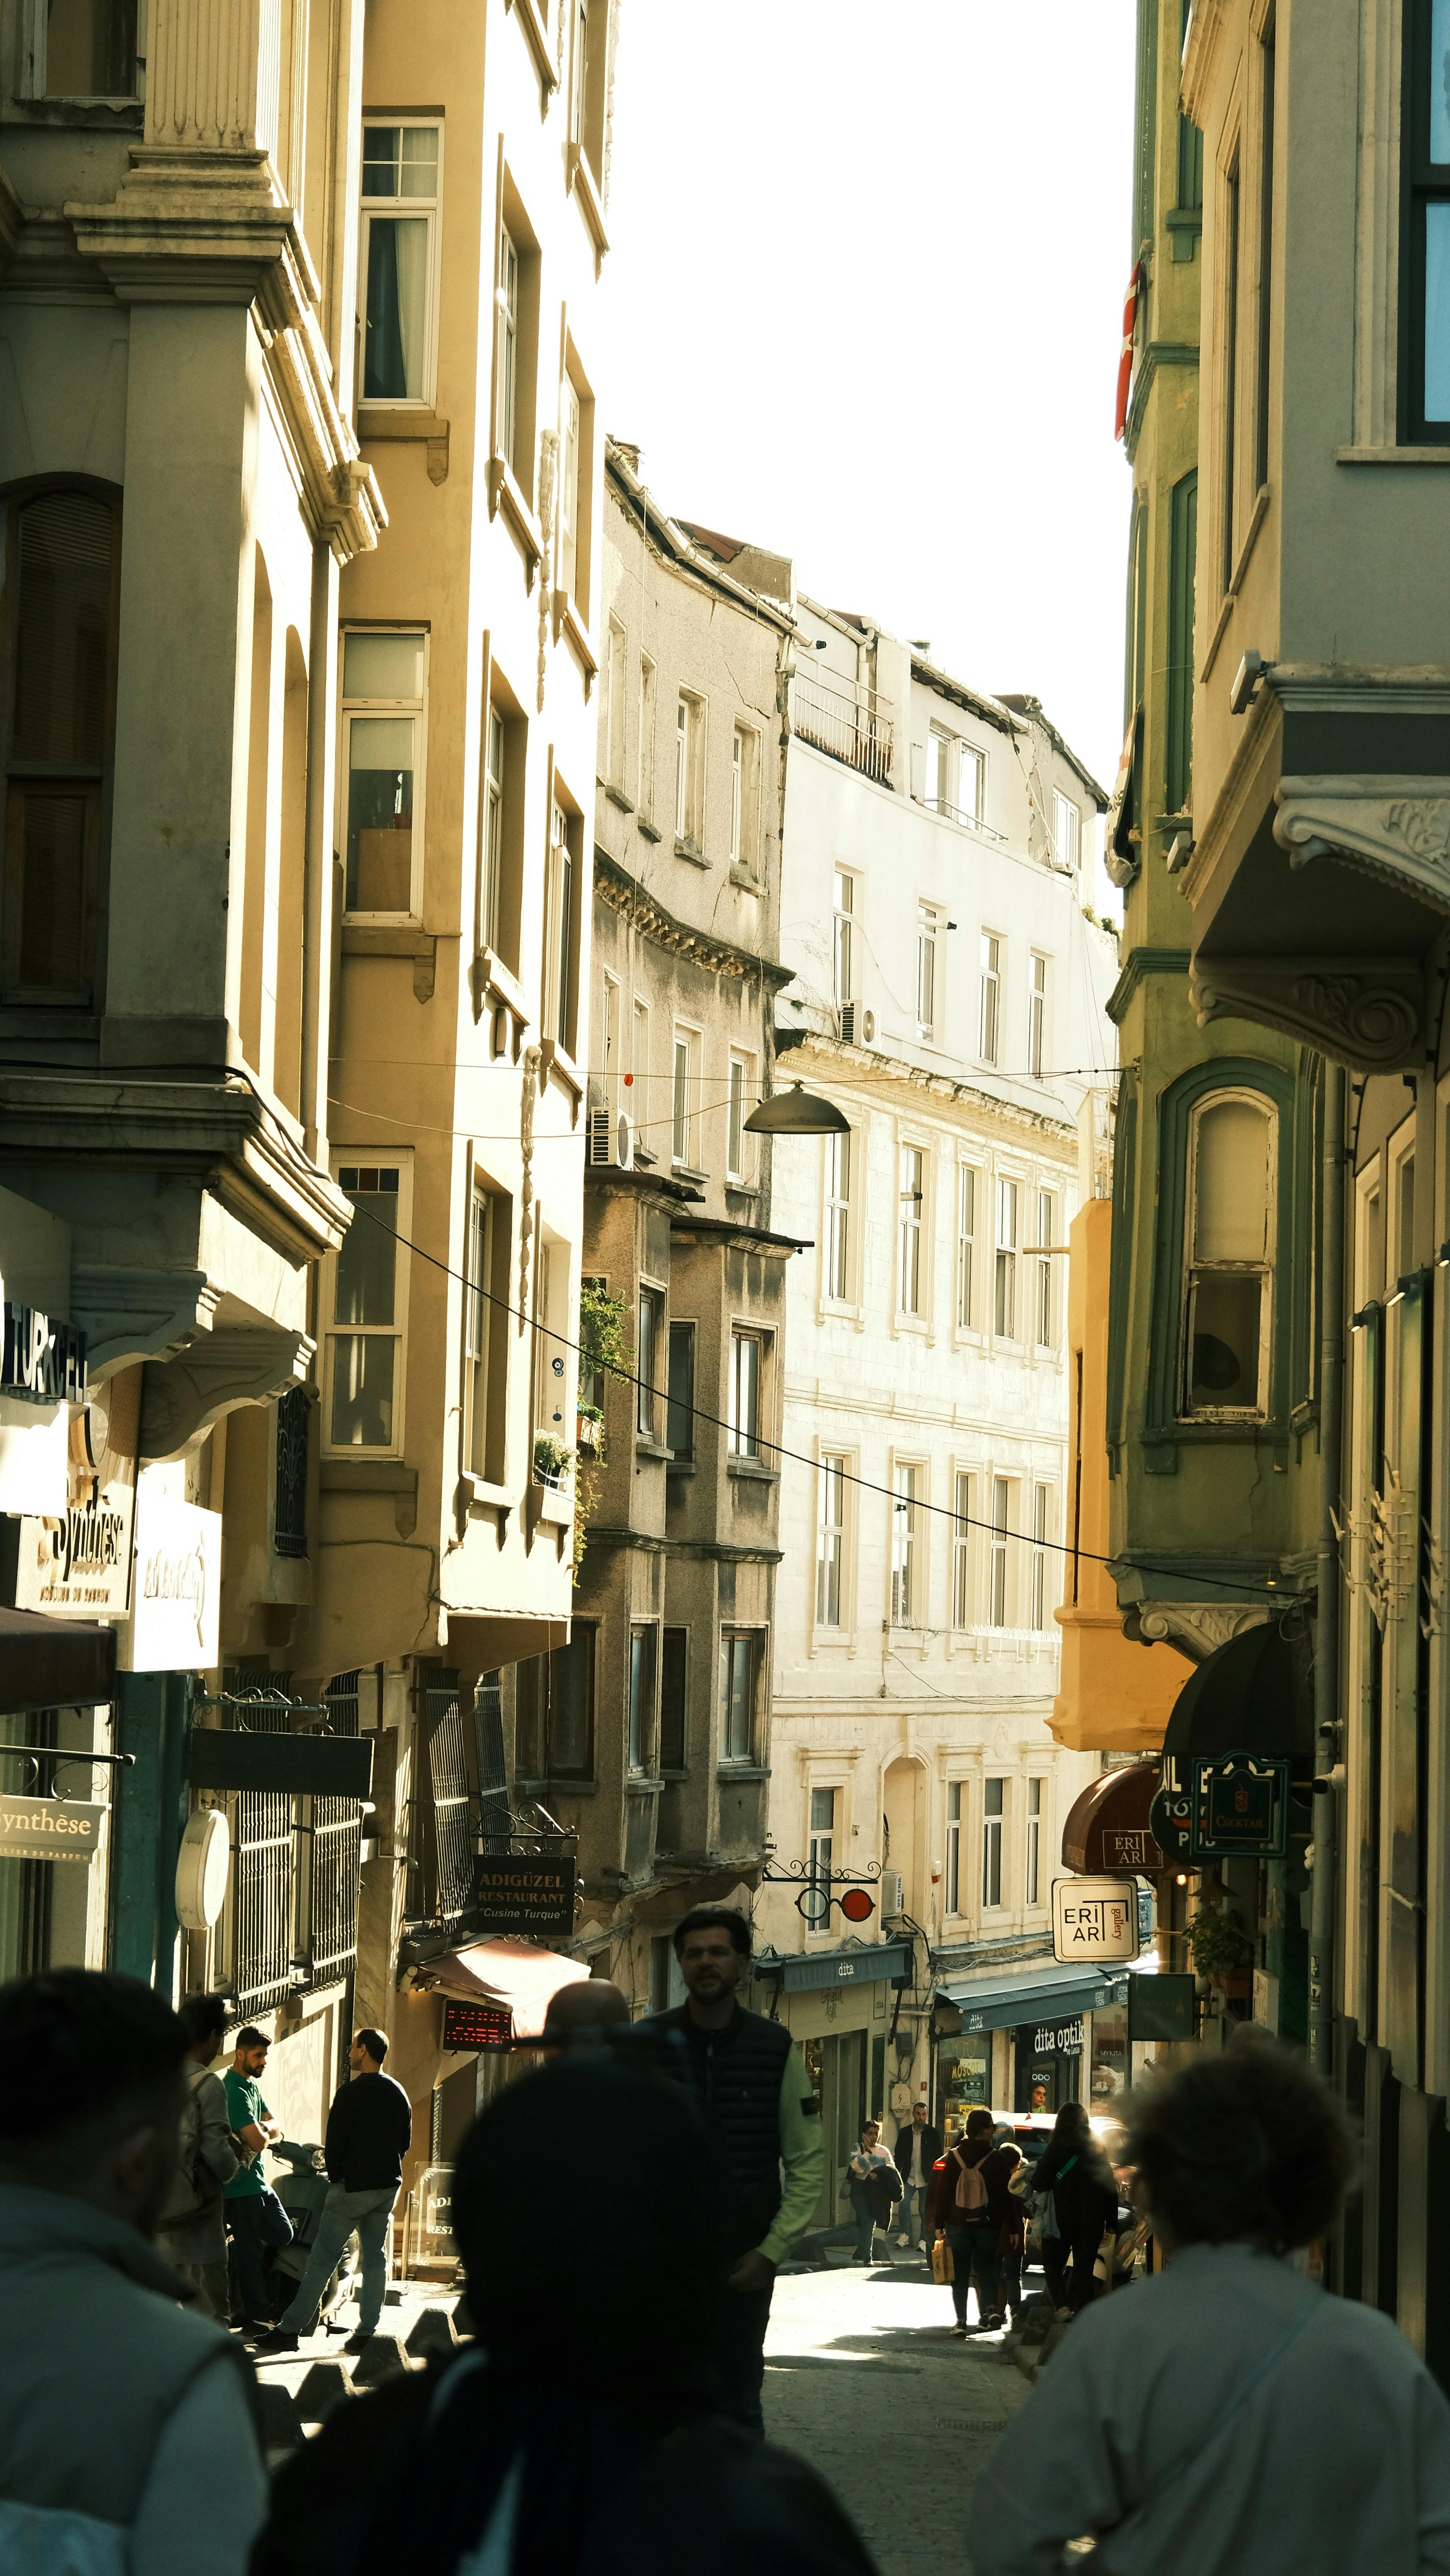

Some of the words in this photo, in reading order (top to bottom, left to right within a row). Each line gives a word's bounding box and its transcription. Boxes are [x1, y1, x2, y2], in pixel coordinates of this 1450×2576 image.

[0, 1808, 91, 1835] ynthèse
[479, 1871, 565, 1888] ADIGÜZEL
[478, 1891, 565, 1904] RESTAURANT
[1111, 1908, 1124, 1940] gallery
[838, 1962, 854, 1976] dita
[969, 2014, 983, 2030] dita
[1035, 2027, 1055, 2053] dita
[1057, 2020, 1084, 2052] optik
[952, 2061, 979, 2079] MOSCOT
[426, 2226, 453, 2235] REST
